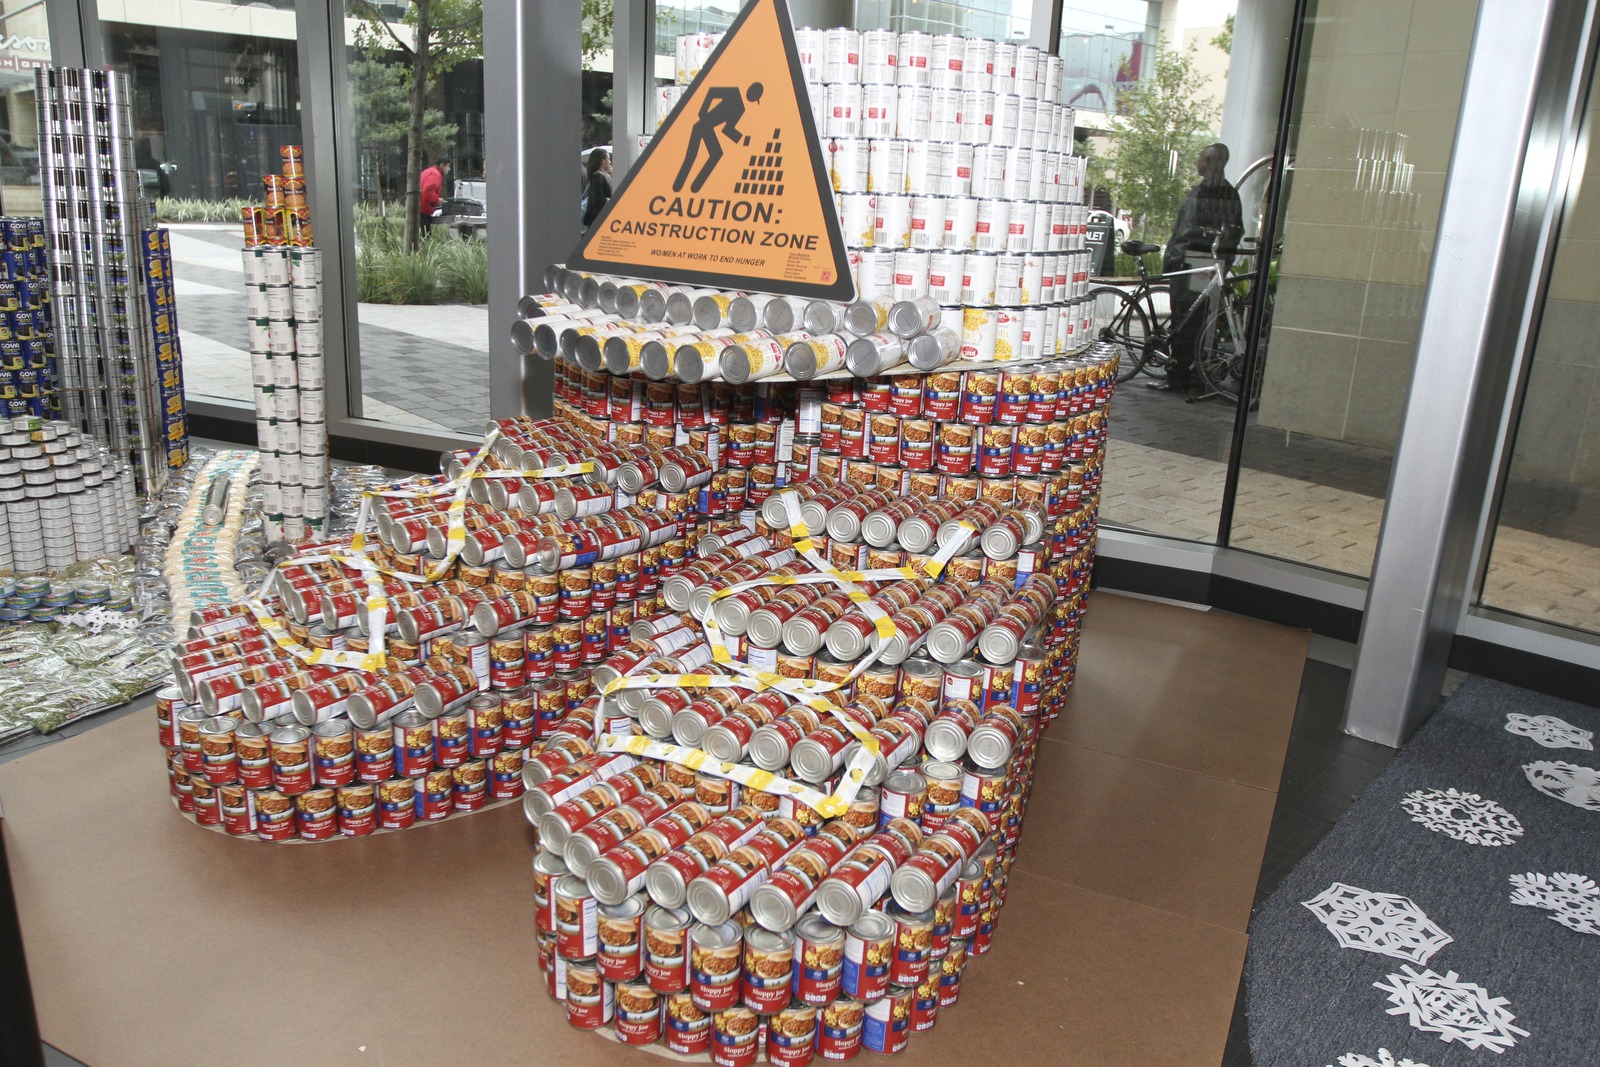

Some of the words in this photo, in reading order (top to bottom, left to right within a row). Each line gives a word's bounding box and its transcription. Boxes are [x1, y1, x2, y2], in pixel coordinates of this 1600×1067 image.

[224, 76, 245, 85] #100
[649, 196, 782, 224] CAUTION:
[610, 220, 755, 246] CANSTRUCTION
[760, 232, 819, 250] ZONE
[1086, 231, 1104, 240] ALET
[687, 252, 708, 261] WORK
[710, 254, 719, 262] TO
[720, 256, 734, 264] END
[736, 257, 766, 267] HUNGER
[892, 396, 904, 404] Sloppy
[902, 450, 916, 458] Sloppy
[942, 454, 956, 462] Sloppy
[670, 692, 680, 700] Joe
[706, 704, 716, 713] Joe
[860, 713, 870, 724] Joe
[736, 720, 746, 729] Joe
[791, 726, 800, 736] Joe
[820, 732, 831, 740] Joe
[342, 764, 352, 772] Joe
[368, 762, 384, 770] Sloppy
[384, 760, 392, 768] Joe
[624, 779, 633, 788] Joe
[571, 804, 581, 813] Joe
[344, 818, 362, 826] Sloppy
[924, 814, 944, 824] Sloppy
[322, 820, 332, 828] Joe
[671, 820, 680, 831] Joe
[719, 820, 729, 829] Joe
[599, 826, 608, 836] Joe
[962, 829, 972, 840] Joe
[763, 836, 773, 846] Joe
[822, 840, 832, 848] Joe
[624, 850, 634, 861] Joe
[924, 856, 934, 864] Joe
[686, 856, 695, 867] Joe
[718, 866, 730, 876] Joe
[790, 876, 800, 886] Joe
[700, 985, 722, 994] Sloppy
[723, 985, 733, 994] Joe
[816, 981, 836, 989] Sloppy
[752, 988, 774, 997] Sloppy
[775, 988, 785, 997] Joe
[619, 1021, 638, 1031] Sloppy
[638, 1024, 648, 1032] Joe
[678, 1032, 700, 1041] Sloppy
[700, 1029, 709, 1038] Joe
[834, 1039, 855, 1047] Sloppy
[724, 1046, 746, 1055] Sloppy
[746, 1042, 755, 1052] Joe
[779, 1047, 801, 1056] Sloppy
[802, 1045, 811, 1054] Joe
